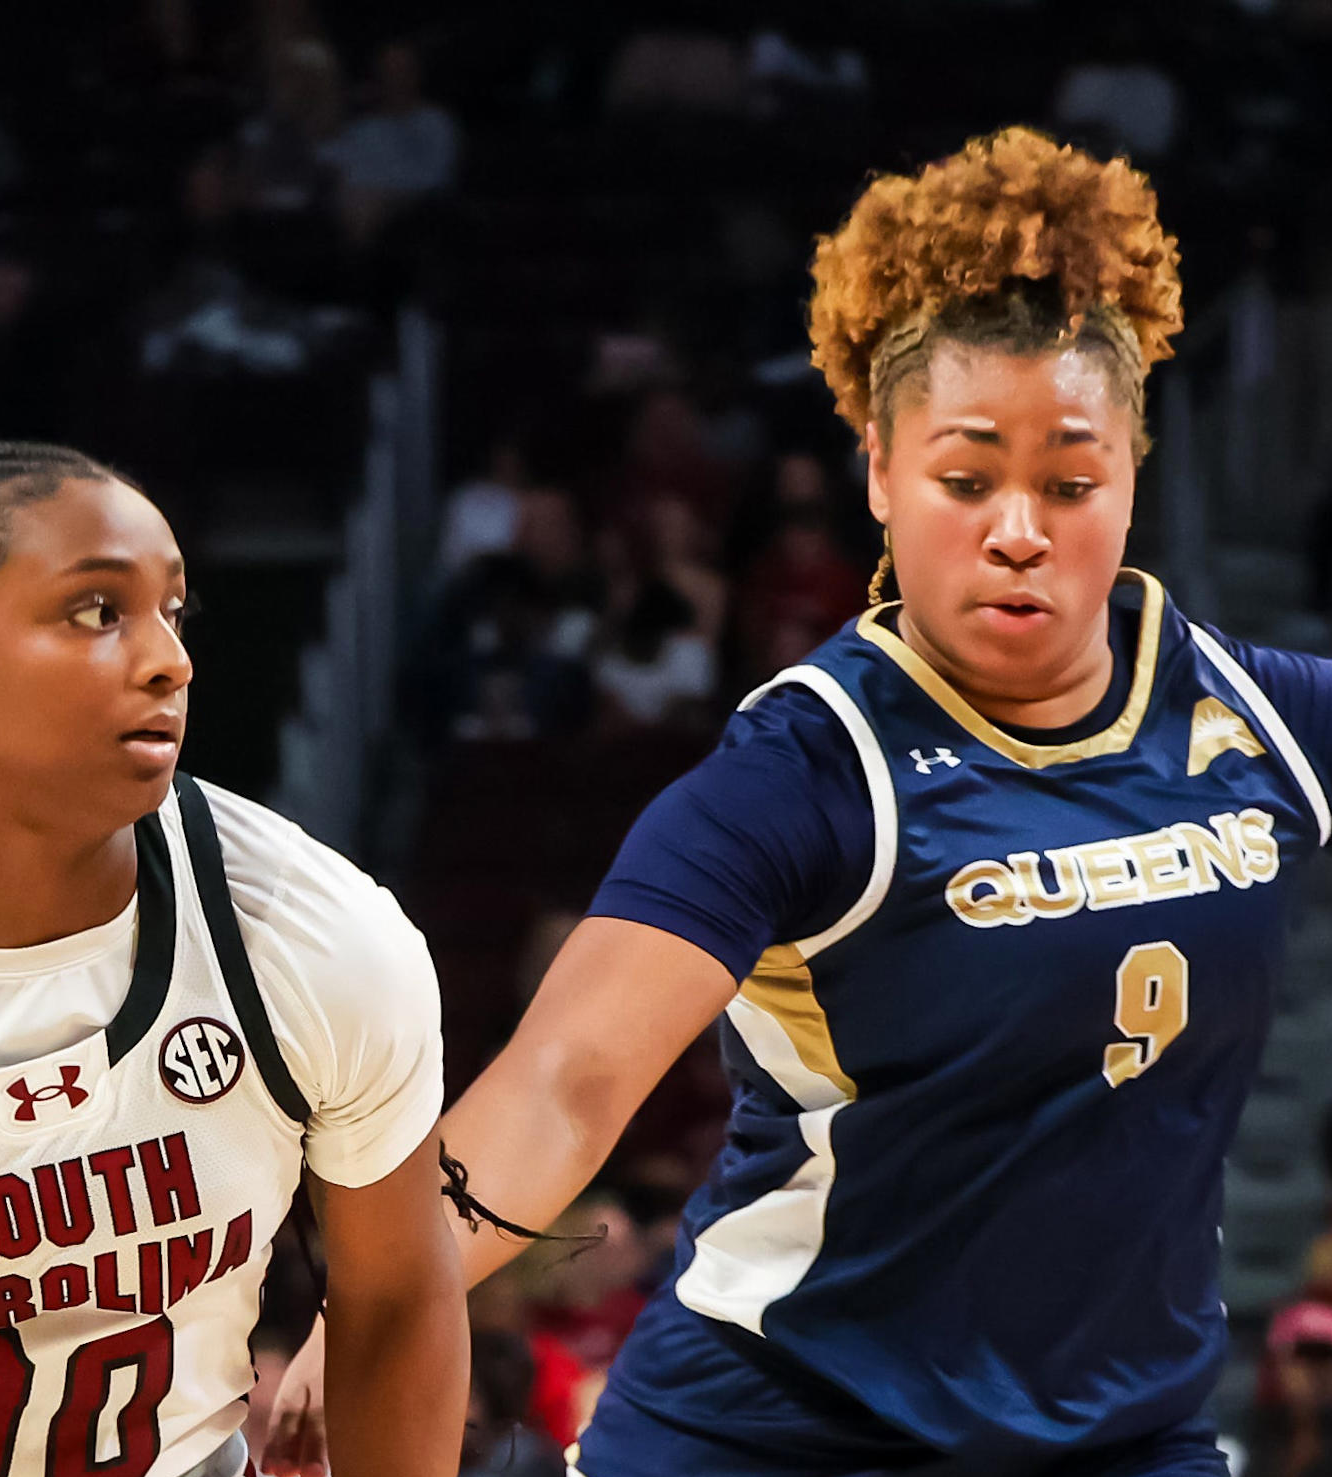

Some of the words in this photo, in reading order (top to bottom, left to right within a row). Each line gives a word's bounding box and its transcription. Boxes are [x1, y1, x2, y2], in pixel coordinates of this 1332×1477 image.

[945, 808, 1281, 929] QUEENS
[163, 1022, 240, 1098] SEC
[1102, 941, 1189, 1089] 9
